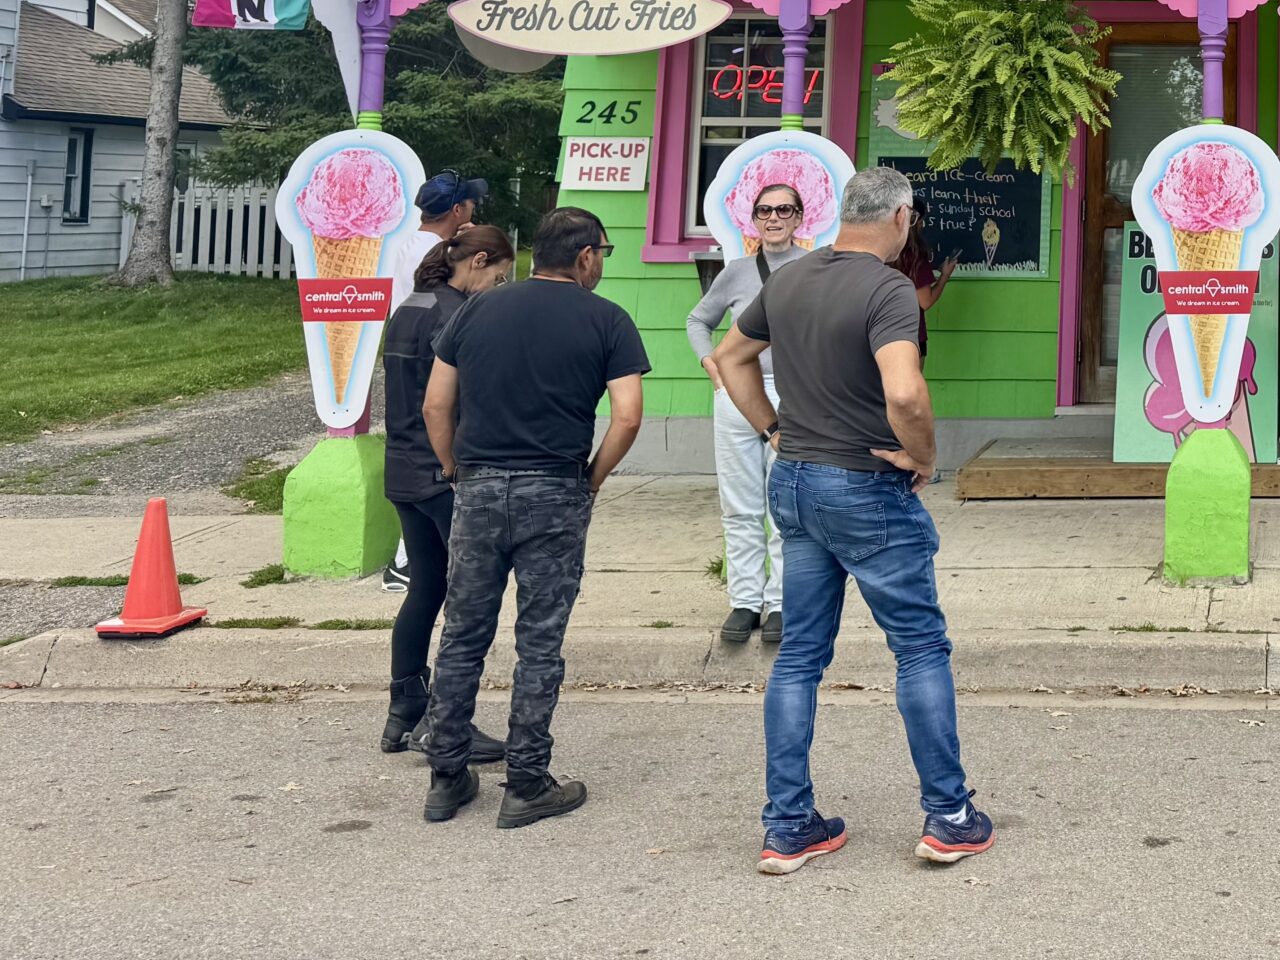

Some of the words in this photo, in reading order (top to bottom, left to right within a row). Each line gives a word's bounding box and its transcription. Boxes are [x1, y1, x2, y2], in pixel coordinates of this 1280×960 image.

[568, 0, 621, 31] Cut
[625, 0, 698, 31] Fries
[575, 100, 642, 124] 245
[569, 142, 646, 159] PICK-UP
[578, 166, 631, 182] HERE
[305, 291, 342, 301] central
[357, 290, 385, 301] smith
[1168, 284, 1206, 295] central
[1220, 283, 1249, 294] smith
